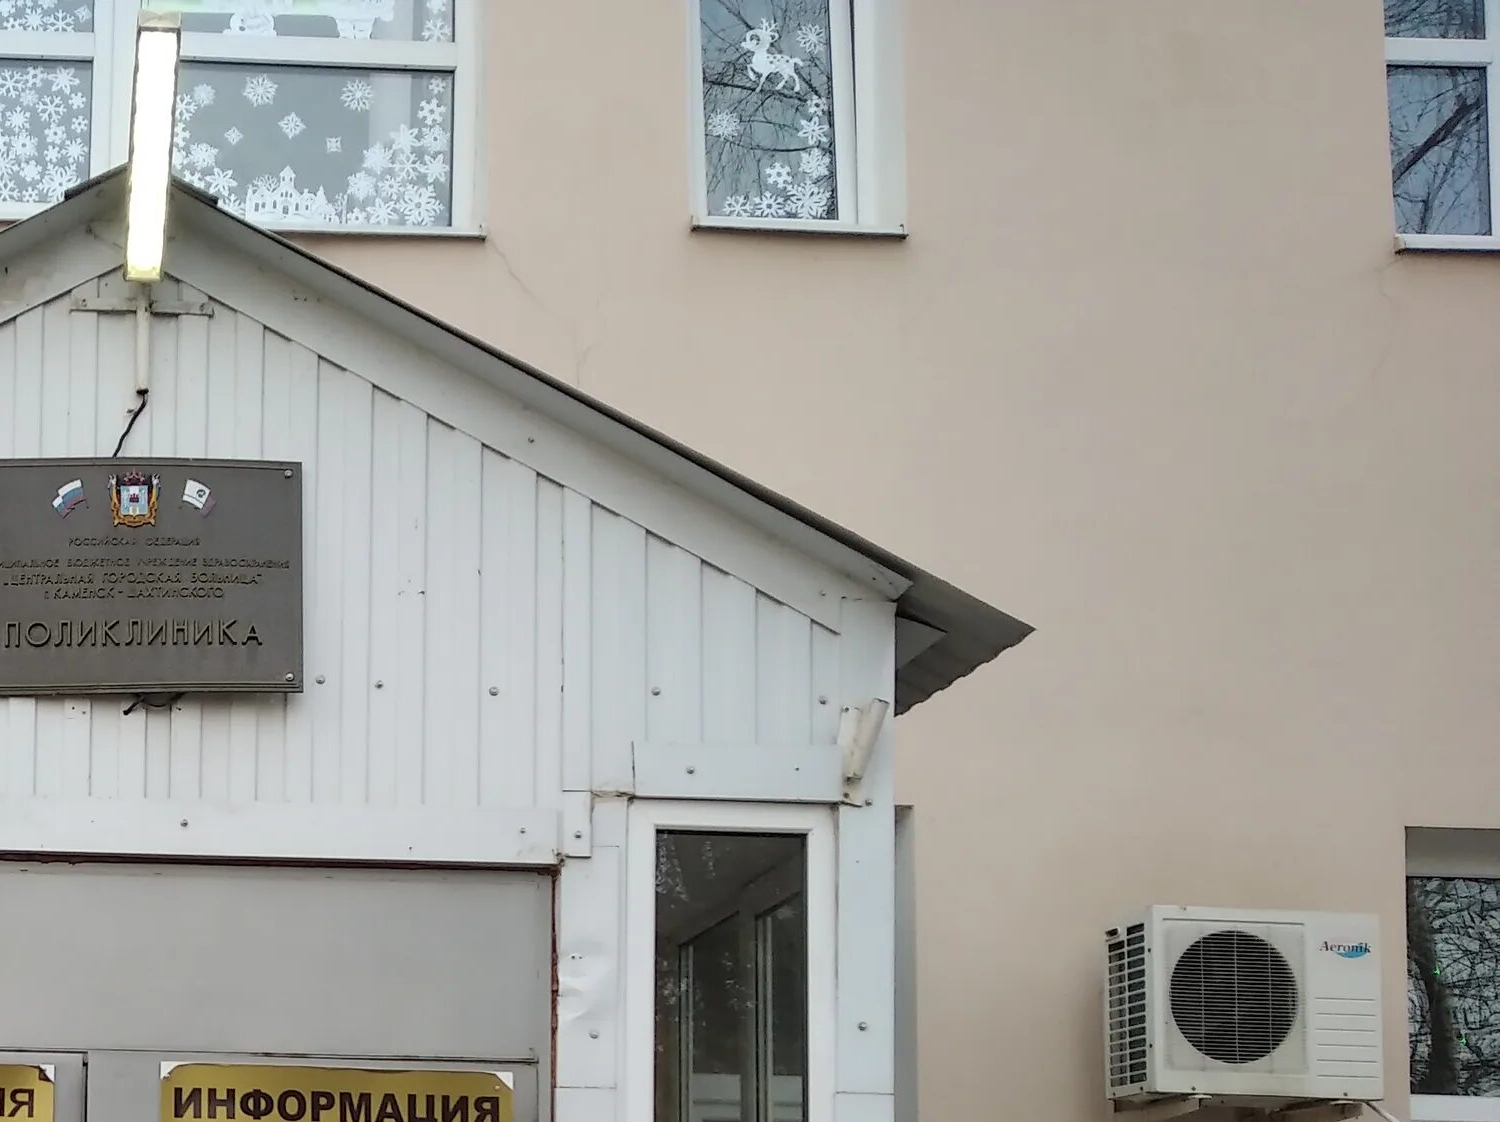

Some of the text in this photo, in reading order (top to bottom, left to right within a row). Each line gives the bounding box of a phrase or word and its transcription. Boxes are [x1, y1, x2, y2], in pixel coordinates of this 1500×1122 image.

[102, 572, 182, 584] ГОРОДСКАЯ
[4, 618, 264, 649] ПОЛИКЛИНИКА
[1319, 940, 1371, 953] Aeronik
